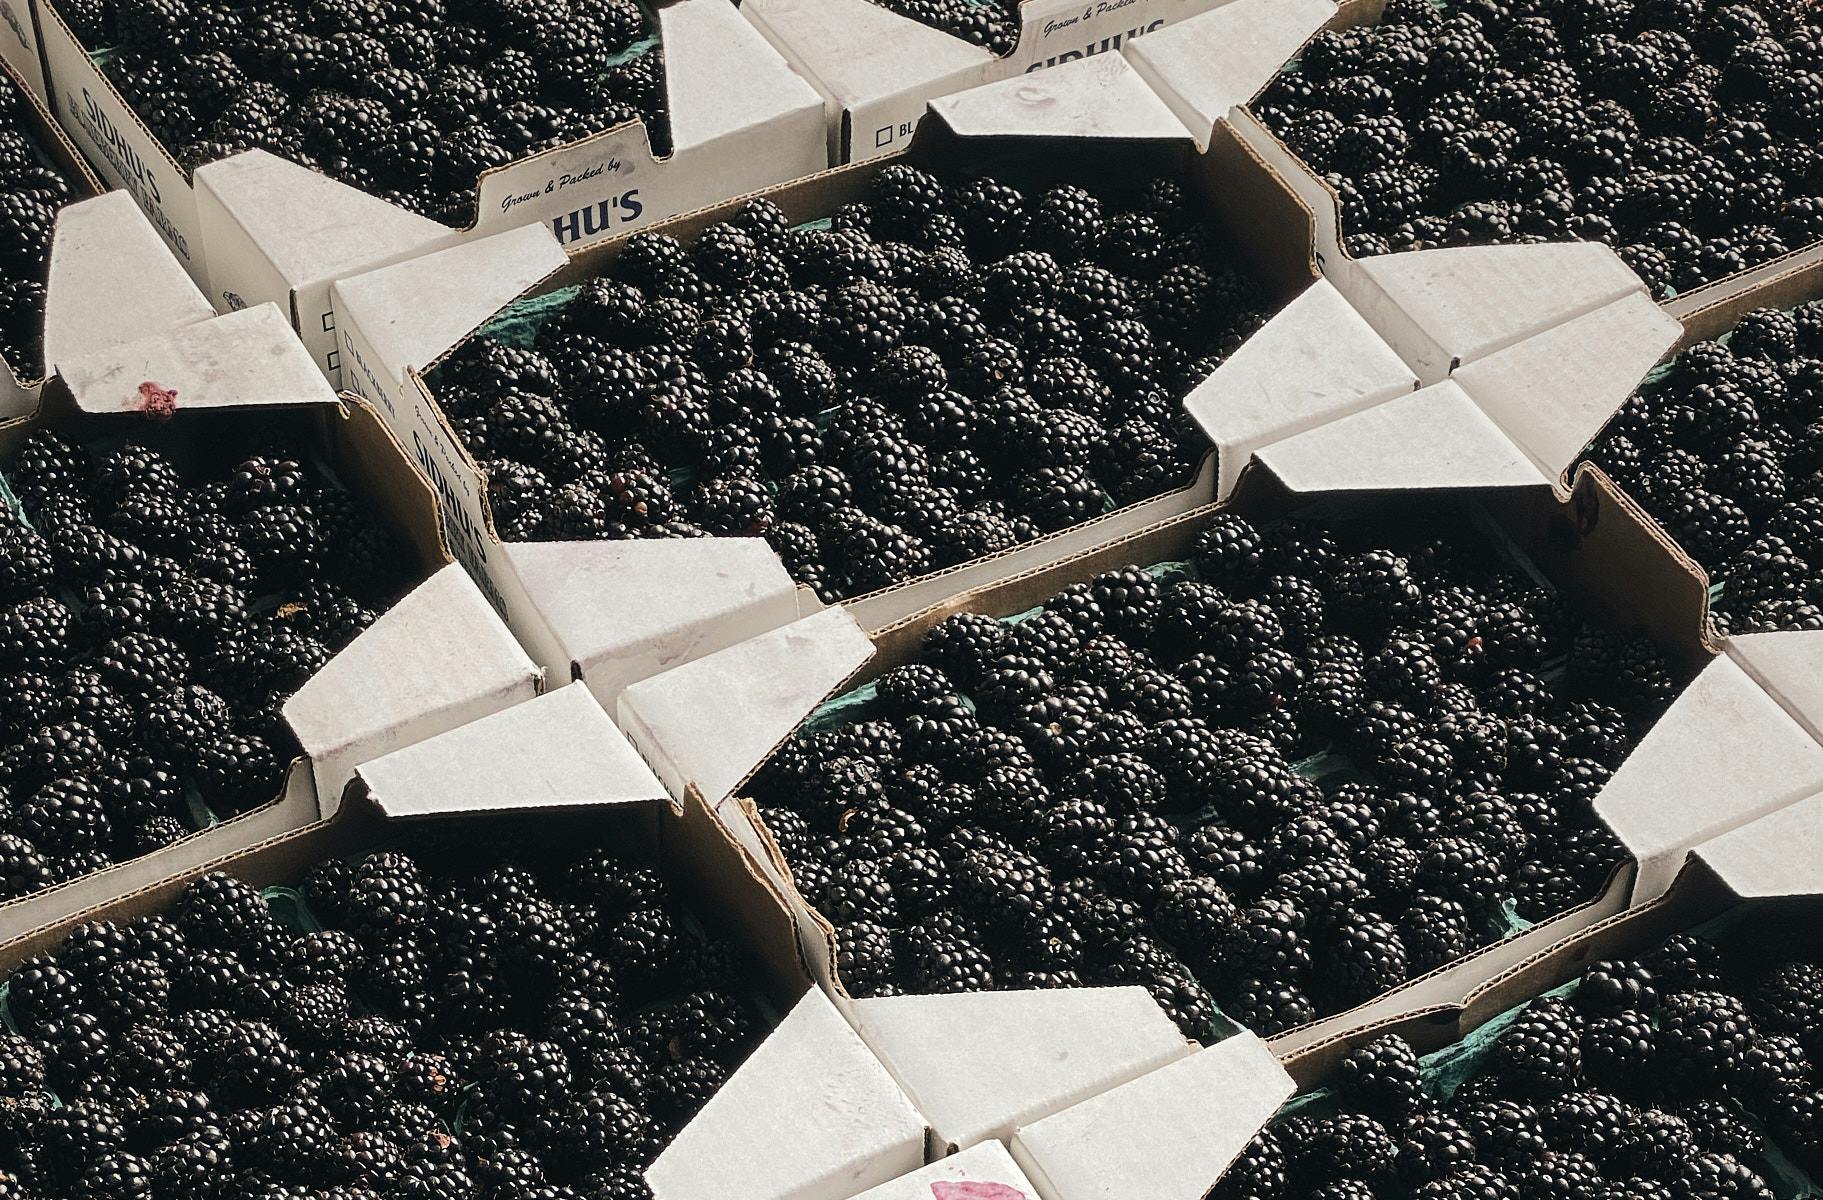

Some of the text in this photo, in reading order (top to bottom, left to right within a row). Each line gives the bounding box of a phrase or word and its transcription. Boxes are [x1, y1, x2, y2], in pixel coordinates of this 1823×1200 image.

[1043, 16, 1079, 38] Grown
[1082, 7, 1093, 21] &
[82, 87, 161, 204] SIDHU'S
[501, 157, 622, 213] Grown & Packed by
[412, 430, 487, 564] SIDHU'S
